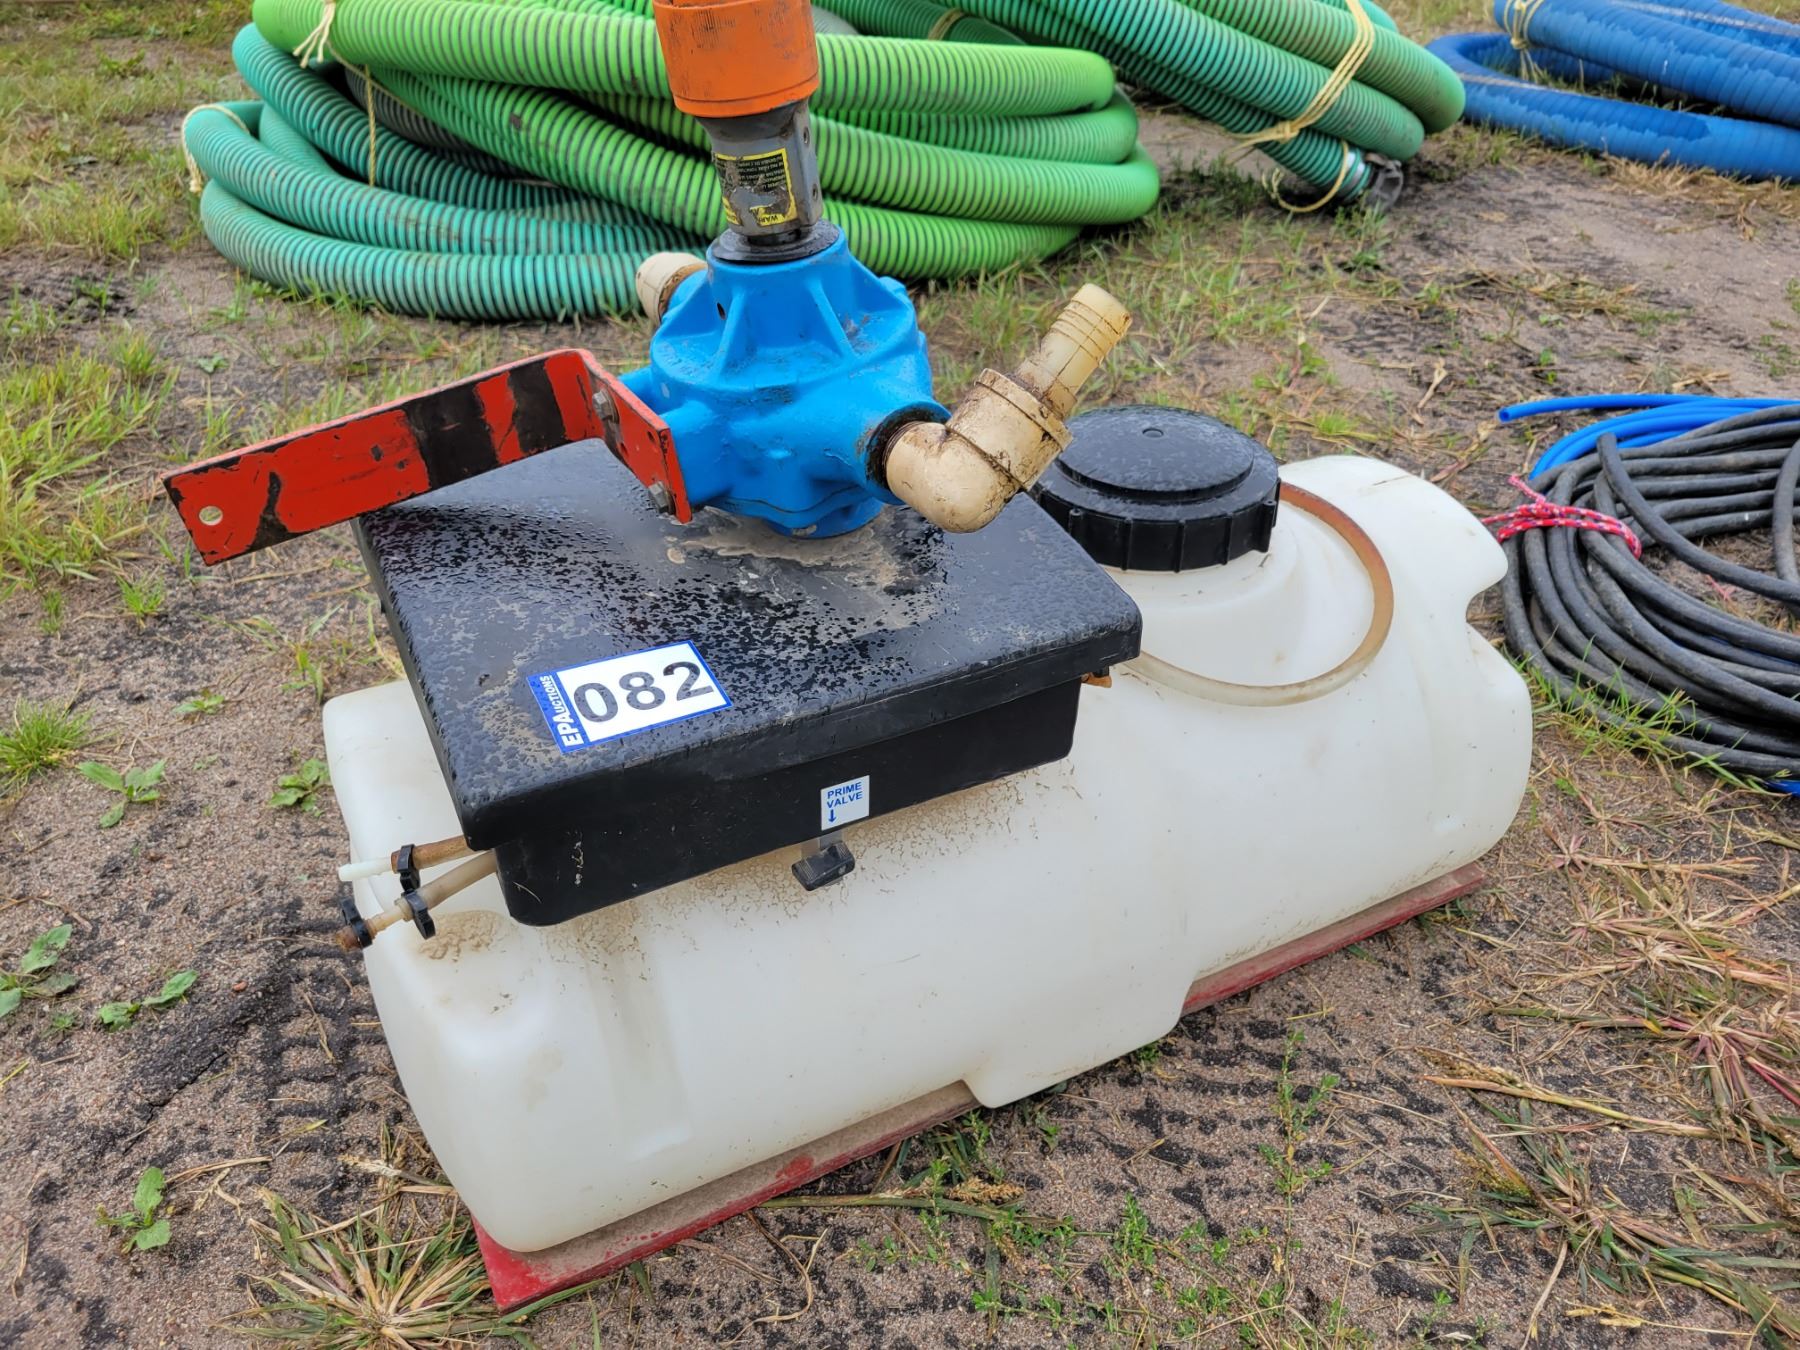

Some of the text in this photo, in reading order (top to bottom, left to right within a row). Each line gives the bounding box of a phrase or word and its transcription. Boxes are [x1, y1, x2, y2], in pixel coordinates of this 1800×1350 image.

[573, 661, 715, 723] 082
[827, 781, 862, 799] PRIME
[826, 791, 863, 809] VALVE
